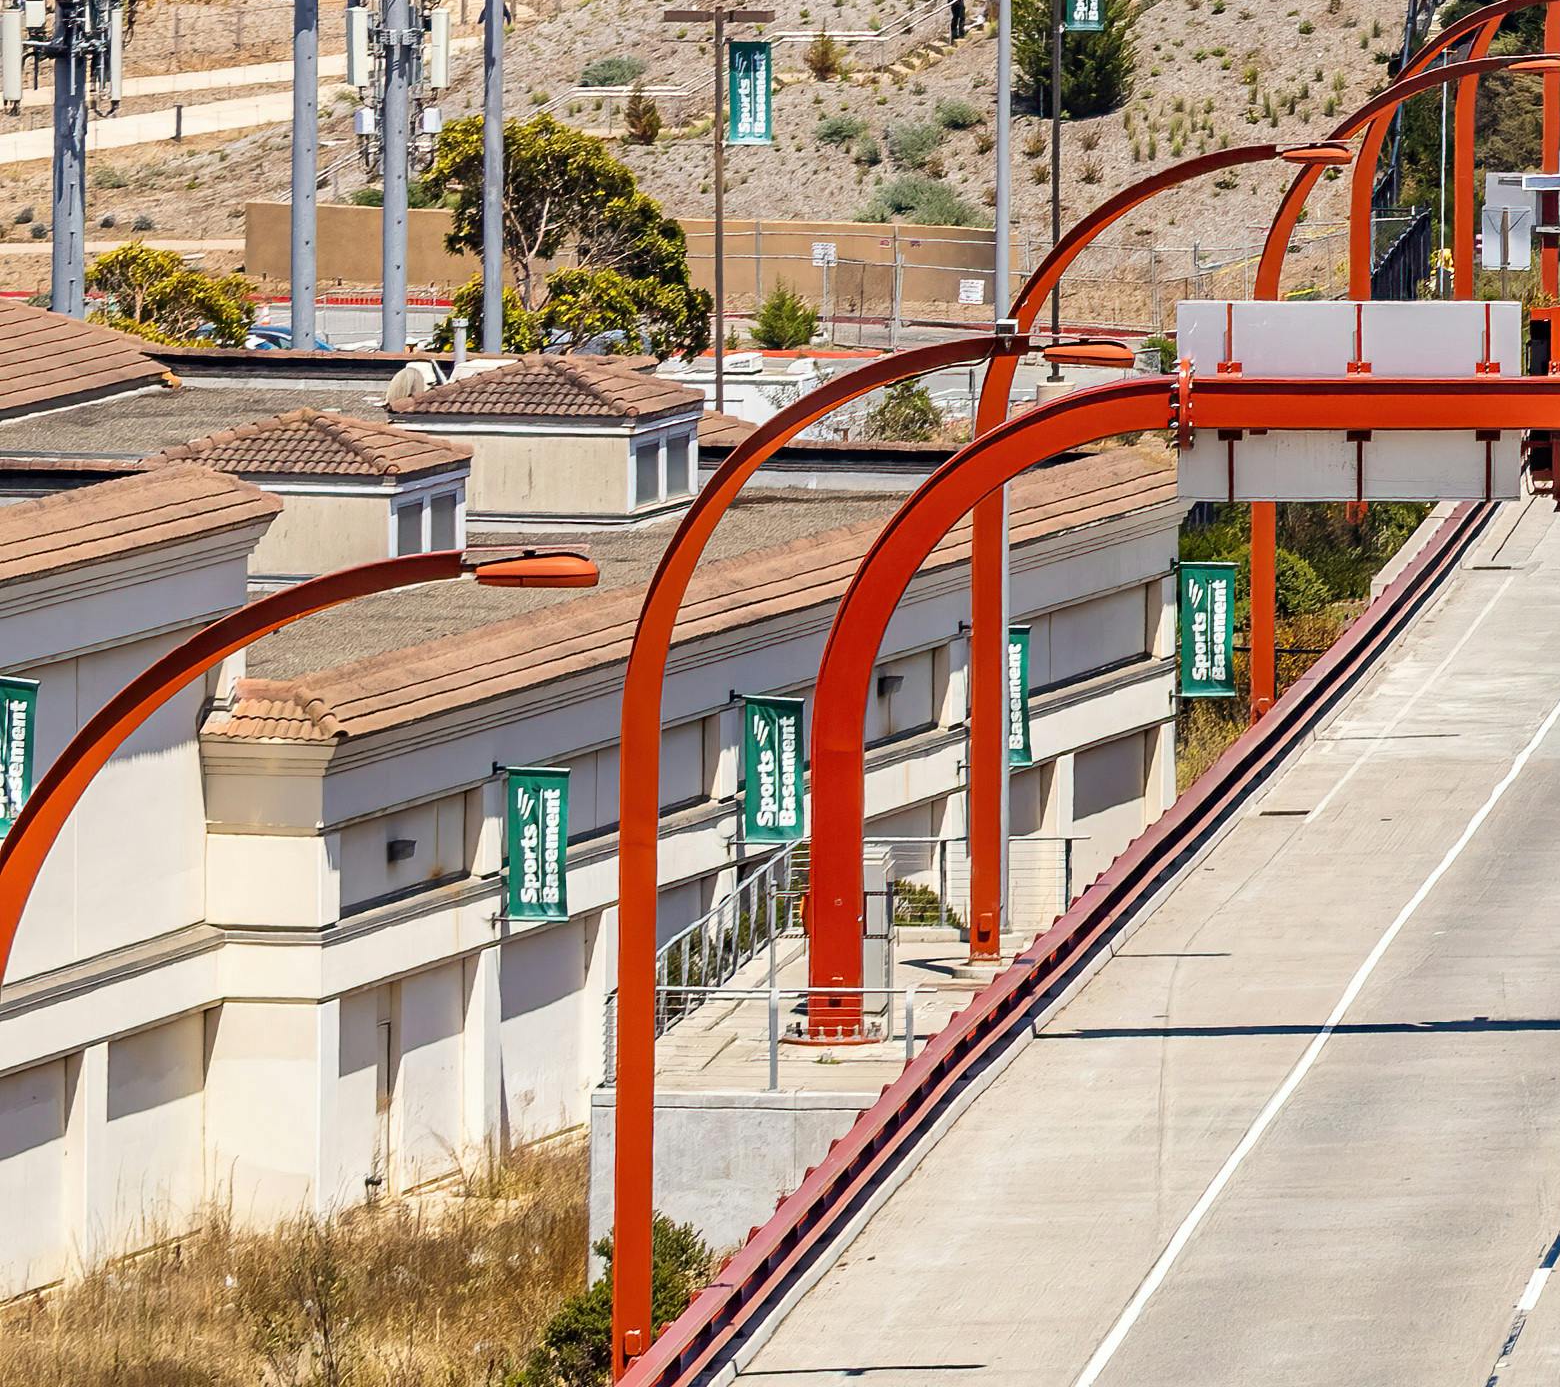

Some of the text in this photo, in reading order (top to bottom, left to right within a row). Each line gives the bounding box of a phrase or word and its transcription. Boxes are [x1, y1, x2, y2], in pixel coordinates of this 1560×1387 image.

[738, 78, 752, 138] Sports
[754, 51, 766, 138] Basement
[1191, 612, 1211, 681] Sports
[1212, 579, 1227, 681] Basement
[1008, 643, 1024, 749] Basement
[756, 749, 777, 827] Sports
[779, 715, 797, 827] Basement
[520, 823, 541, 904] Sports
[543, 788, 561, 904] Basement
